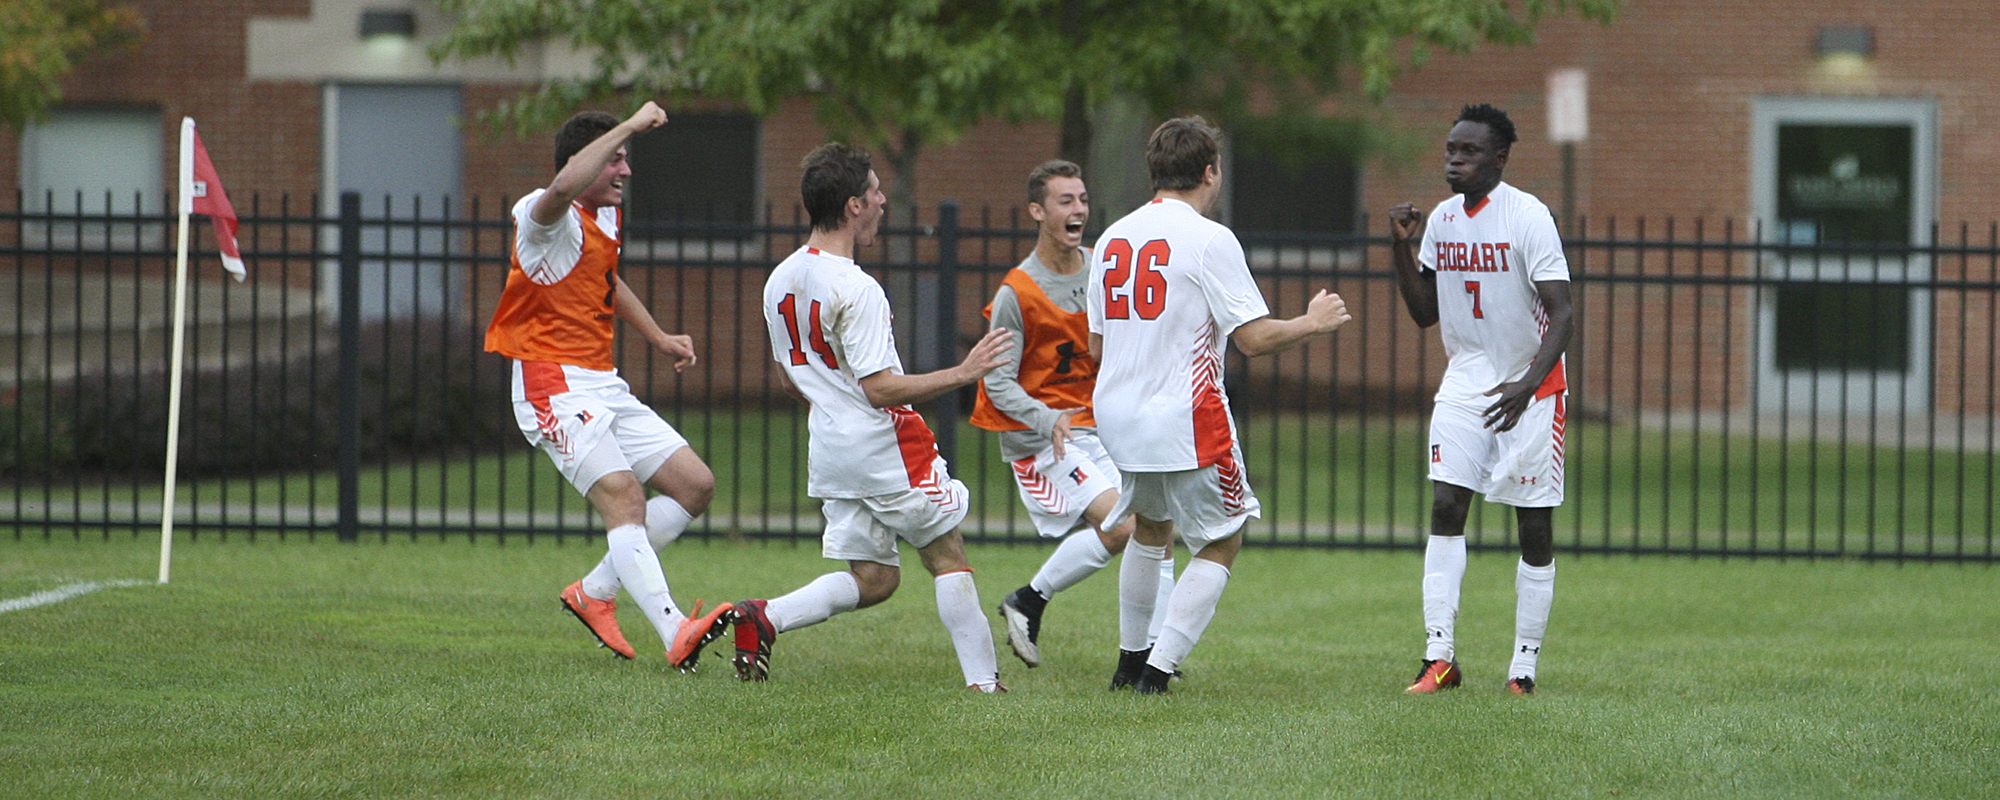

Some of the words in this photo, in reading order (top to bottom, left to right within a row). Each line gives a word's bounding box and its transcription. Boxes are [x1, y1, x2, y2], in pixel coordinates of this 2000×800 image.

[1436, 242, 1511, 272] HOBART
[1102, 238, 1172, 320] 26
[1465, 281, 1484, 319] 7
